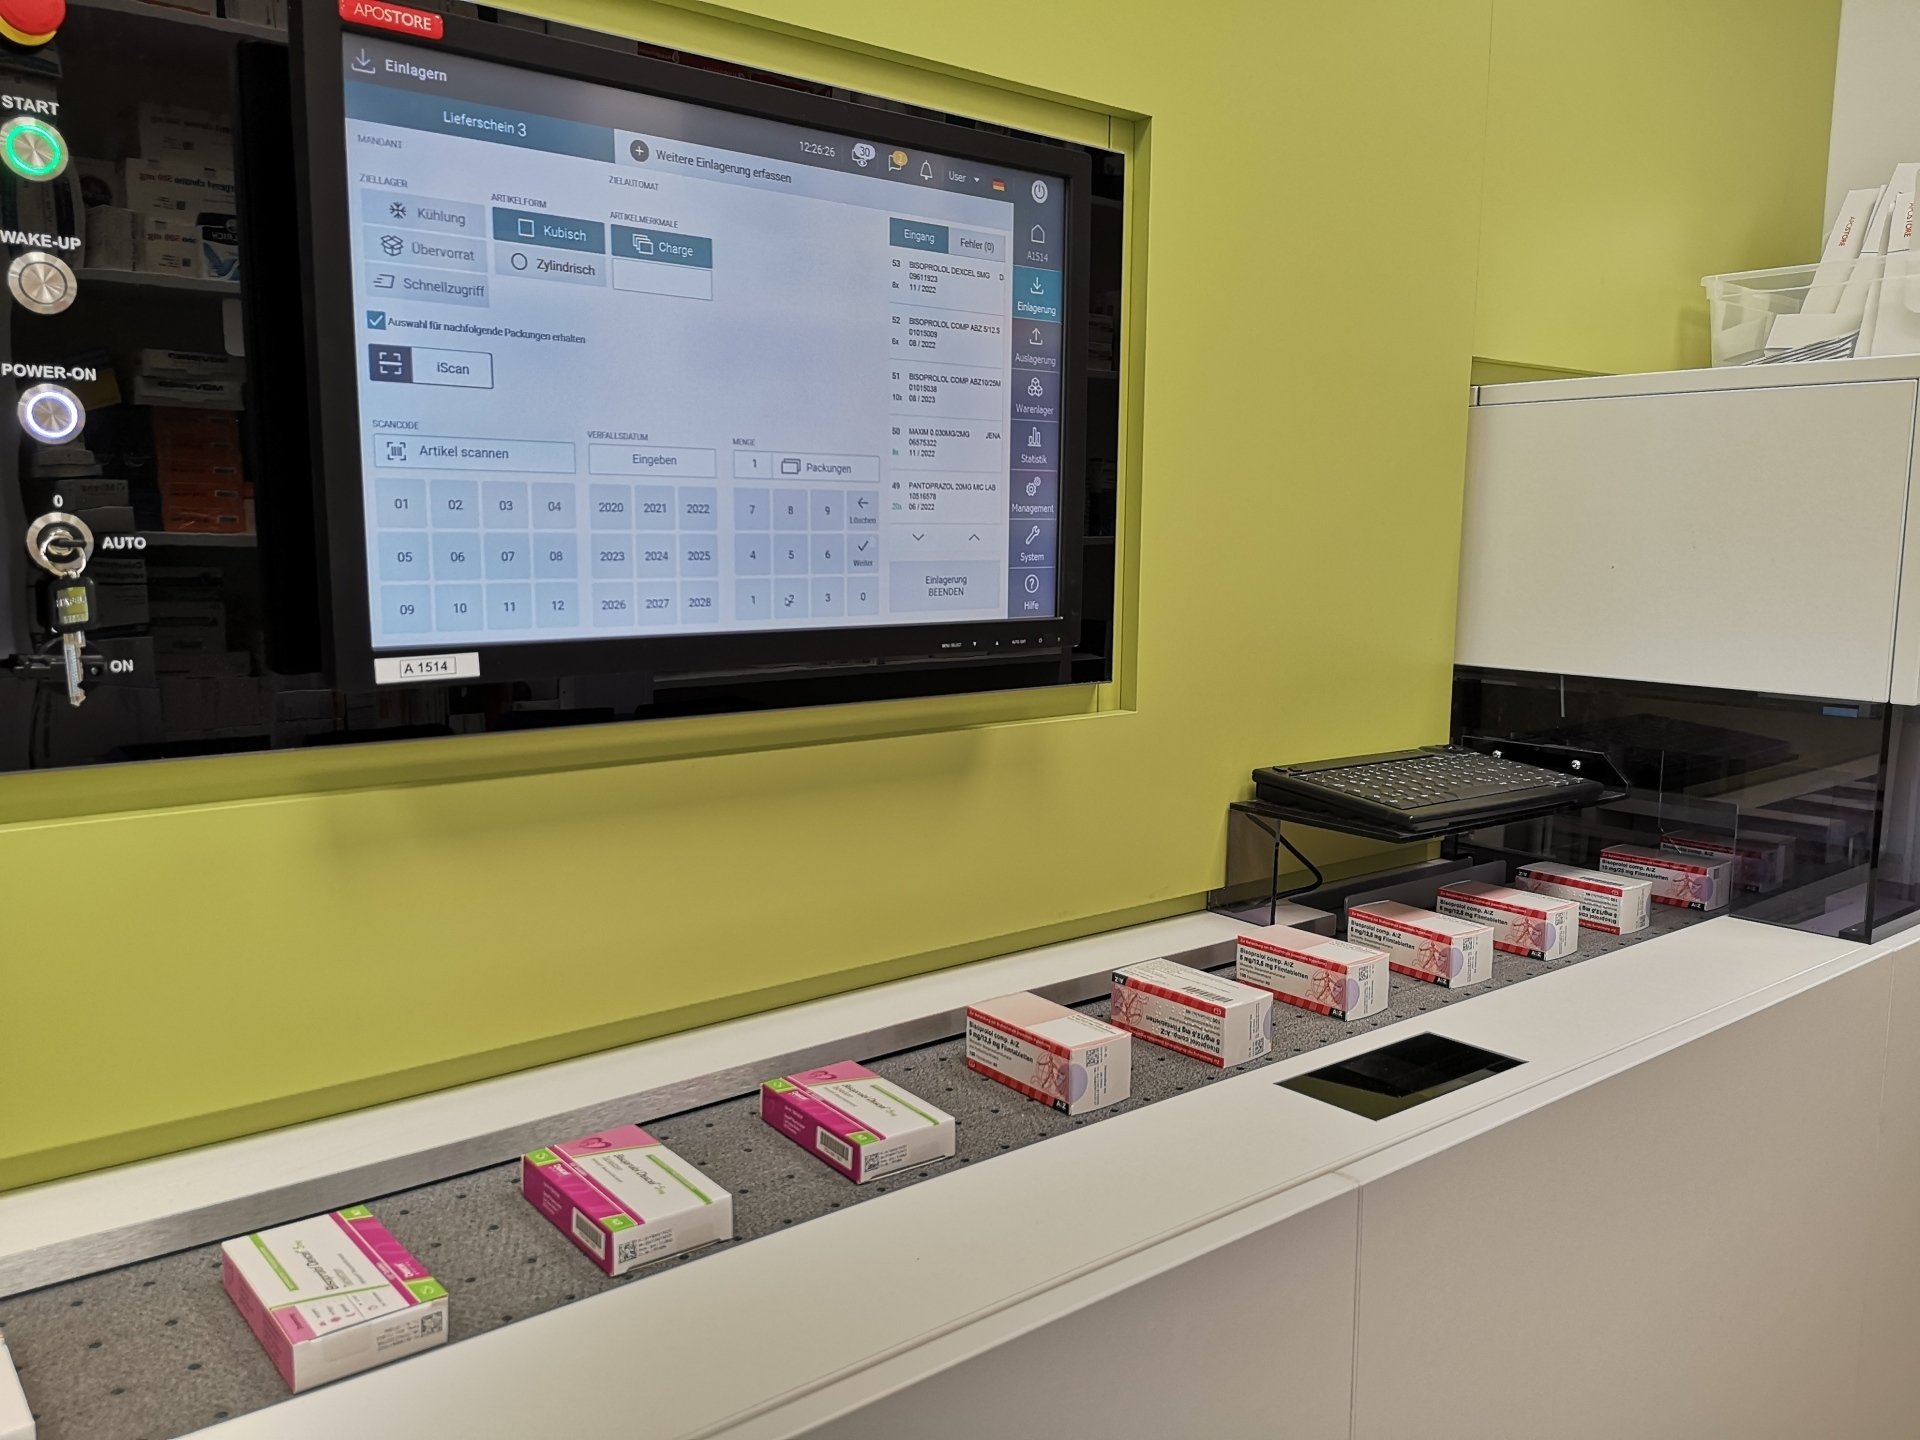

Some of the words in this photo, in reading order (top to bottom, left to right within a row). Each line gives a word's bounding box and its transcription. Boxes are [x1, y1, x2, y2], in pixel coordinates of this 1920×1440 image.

[354, 3, 432, 32] APOSTORE
[385, 59, 447, 82] Einlagern
[1, 95, 59, 116] START
[443, 111, 515, 135] Lieferschein
[518, 122, 527, 137] 3
[357, 134, 403, 149] MANDANT
[800, 141, 836, 158] 12:26:26
[860, 146, 871, 157] 30
[656, 149, 694, 166] Weitere
[696, 157, 751, 179] Einlagerung
[753, 166, 792, 184] erfassen
[359, 173, 408, 188] ZIELLAGER
[609, 175, 659, 191] ZIELAUTOMAT
[949, 171, 967, 183] User
[491, 193, 547, 208] ARTIKELFORM
[417, 207, 466, 227] Kühlung
[610, 211, 678, 229] ARTIKELMERKMALE
[0, 229, 82, 250] WAKE-UP
[543, 225, 587, 242] Kubisch
[904, 229, 935, 245] Eingang
[411, 241, 475, 262] Übervorrat
[659, 241, 694, 258] Charge
[960, 238, 983, 250] Fehler
[984, 241, 994, 254] (0)
[1027, 251, 1049, 263] A1514
[536, 258, 595, 276] Zylindrisch
[892, 259, 901, 268] 53
[909, 261, 950, 274] BISOPROLOL
[951, 267, 976, 278] DEXCEL
[976, 271, 991, 279] 5MG
[403, 278, 485, 298] Schnellzugriff
[921, 285, 937, 293] 2022
[1017, 301, 1056, 316] Einlagerung
[387, 317, 427, 330] Auswahl
[429, 320, 442, 331] für
[443, 323, 503, 337] nachfolgende
[504, 328, 551, 341] Packungen
[552, 333, 586, 344] erhalten
[892, 316, 901, 324] 52
[909, 317, 950, 329] BISOPROLOL
[950, 322, 970, 331] COMP
[970, 325, 983, 333] ABZ
[909, 339, 918, 347] 08
[1015, 352, 1056, 366] Auslagerung
[1, 363, 97, 381] POWER-ON
[437, 361, 470, 375] iScan
[892, 372, 900, 380] 51
[909, 373, 949, 384] BISOPROLOL
[950, 376, 969, 385] COMP
[1015, 404, 1055, 415] Warenlager
[372, 419, 419, 430] SCANCODE
[587, 431, 649, 441] VERFALLSDATUM
[909, 428, 929, 436] MAXIM
[732, 438, 755, 446] MENGE
[419, 445, 458, 457] Artikel
[461, 449, 509, 459] scannen
[1021, 454, 1047, 464] Statistik
[632, 454, 677, 466] Eingeben
[806, 463, 852, 475] Packungen
[955, 483, 972, 491] 20MG
[53, 494, 64, 508] 0
[395, 498, 408, 510] 01
[448, 500, 463, 510] 02
[499, 501, 513, 511] 03
[548, 501, 562, 511] 04
[599, 502, 624, 513] 2020
[643, 503, 667, 513] 2021
[687, 504, 710, 514] 2022
[921, 503, 935, 511] 2022
[1011, 504, 1054, 514] Management
[102, 536, 147, 550] AUTO
[397, 552, 412, 562] 05
[450, 552, 465, 562] 06
[501, 552, 515, 562] 07
[549, 551, 563, 562] 08
[600, 551, 625, 562] 2023
[645, 551, 668, 562] 2024
[688, 551, 711, 561] 2025
[1020, 552, 1044, 562] System
[925, 575, 967, 585] Einlagerung
[928, 588, 964, 596] BEENDEN
[400, 605, 415, 615] 09
[453, 603, 467, 614] 10
[504, 602, 516, 612] 11
[552, 600, 565, 611] 12
[602, 600, 626, 610] 2026
[646, 599, 669, 609] 2027
[689, 598, 711, 608] 2028
[1024, 601, 1039, 610] Hilfe
[110, 659, 134, 673] ON
[404, 663, 414, 674] A
[418, 661, 448, 673] 1514
[1601, 859, 1628, 868] Bisoprolol
[1628, 864, 1645, 872] comp.
[1635, 870, 1669, 881] Filmtabletten
[1439, 899, 1466, 911] Bisoprolol
[1466, 905, 1483, 915] comp.
[1474, 913, 1508, 926] Filmtabletten
[1350, 919, 1375, 932] Bisoprolol
[1375, 926, 1391, 936] comp.
[1382, 935, 1415, 950] Filmtabletten
[1239, 947, 1267, 962] Bisoprolol
[1266, 955, 1283, 966] comp.
[1264, 963, 1274, 971] mg
[1274, 965, 1309, 980] Filmtabletten
[1145, 1014, 1181, 1032] Filmtabletten
[969, 1020, 994, 1037] Bisoprolol
[994, 1032, 1010, 1045] comp.
[1171, 1031, 1189, 1043] comp.
[1190, 1038, 1220, 1054] Bisoprolol
[1001, 1043, 1034, 1064] Filmtabletten
